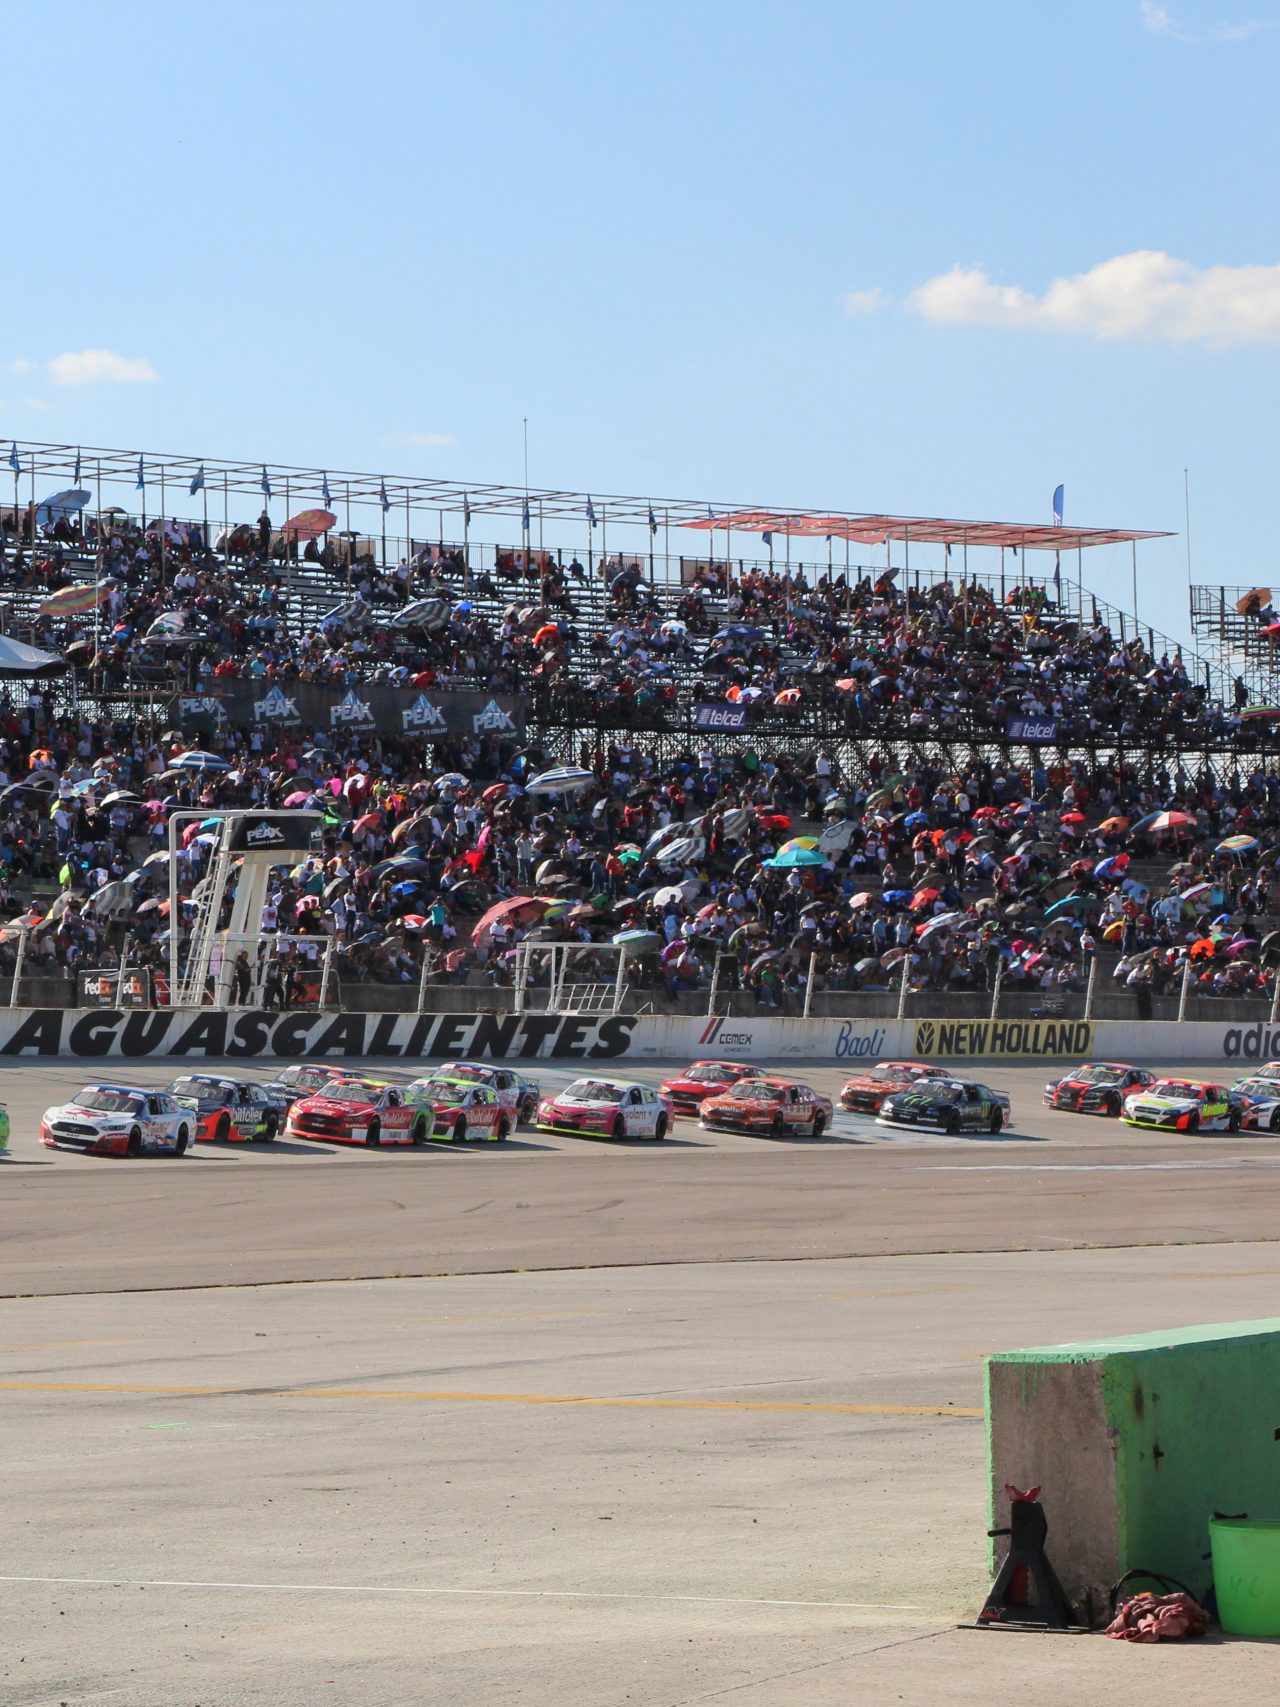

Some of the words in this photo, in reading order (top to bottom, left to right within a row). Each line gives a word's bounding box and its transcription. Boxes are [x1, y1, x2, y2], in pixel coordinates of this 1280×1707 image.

[254, 697, 300, 721] PEAK
[330, 702, 375, 725] PEAK
[402, 706, 446, 729] PEAK
[709, 709, 744, 726] telcel
[472, 711, 516, 734] PEAK
[1022, 722, 1055, 738] telcel
[246, 827, 284, 842] PEAK
[122, 976, 142, 996] edEx
[719, 1033, 753, 1045] CEMEX
[835, 1020, 886, 1058] Baoli
[937, 1023, 990, 1055] NEW
[991, 1023, 1092, 1055] HOLLAND
